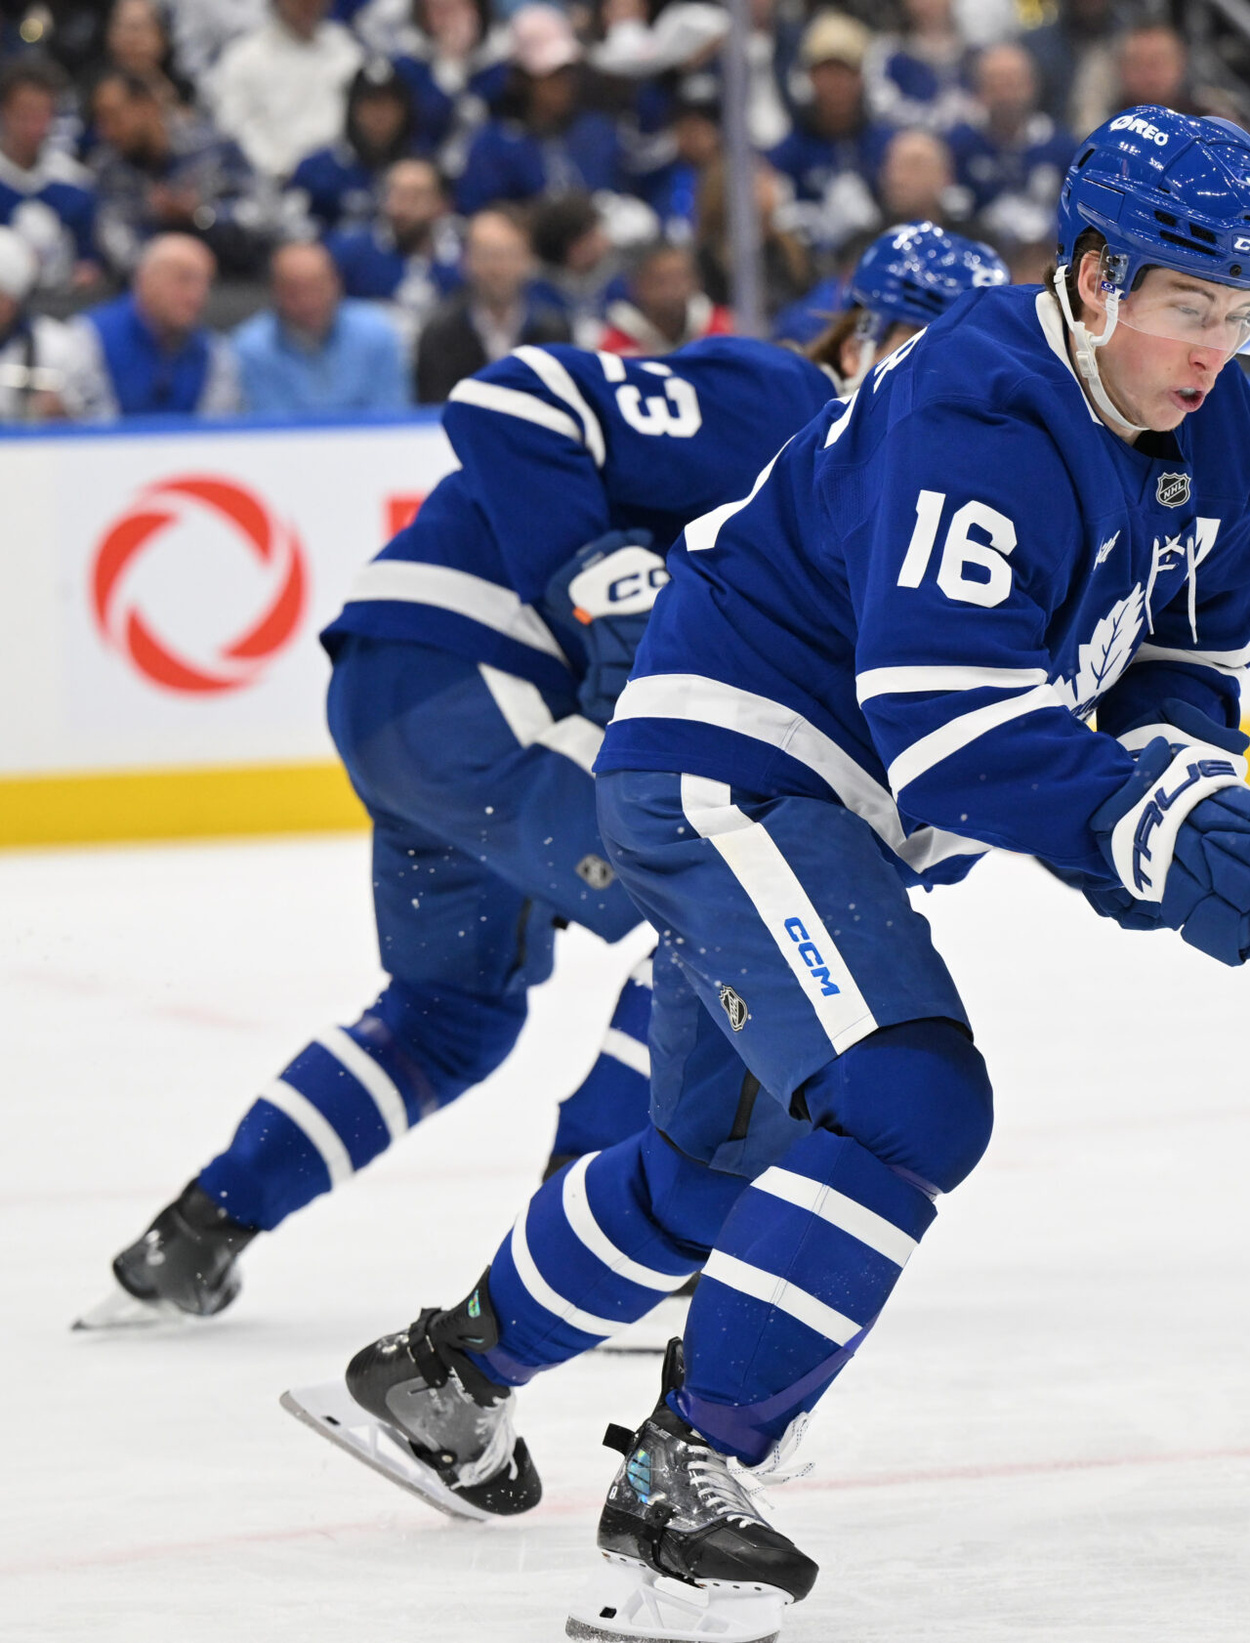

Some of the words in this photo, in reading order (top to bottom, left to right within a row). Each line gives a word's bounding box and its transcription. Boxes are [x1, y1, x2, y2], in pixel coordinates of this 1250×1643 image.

[1110, 115, 1169, 147] OREO
[1163, 481, 1185, 500] NHL
[896, 489, 1018, 609] 16
[608, 566, 673, 603] CC
[1132, 759, 1238, 894] TRUE
[784, 916, 841, 997] CCM
